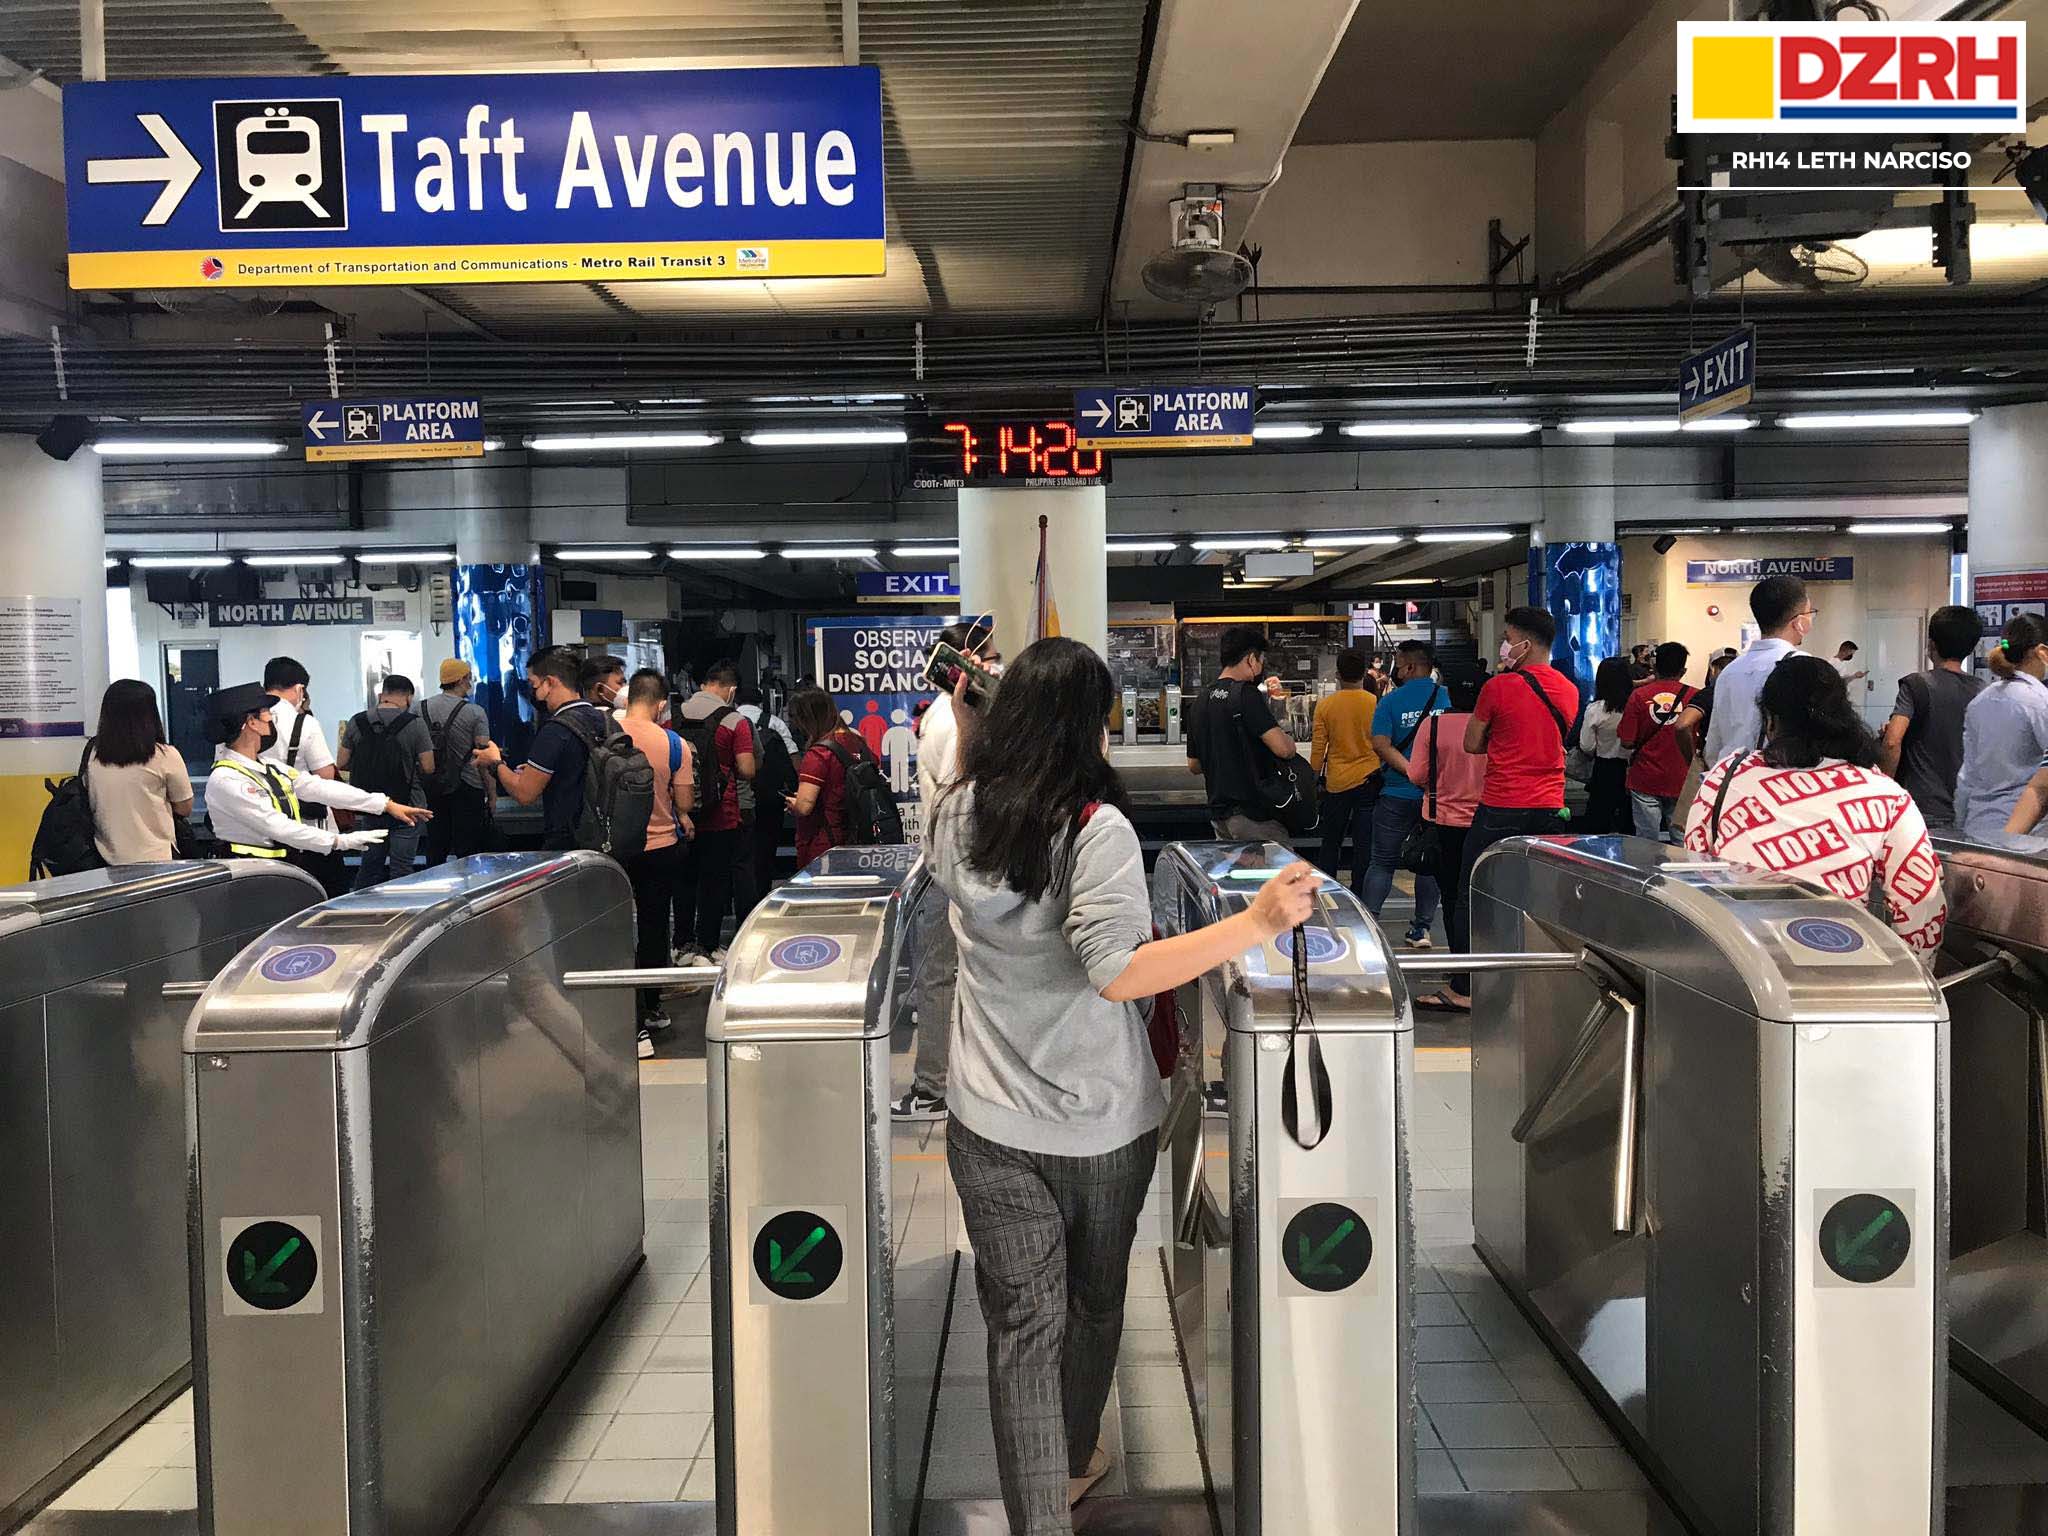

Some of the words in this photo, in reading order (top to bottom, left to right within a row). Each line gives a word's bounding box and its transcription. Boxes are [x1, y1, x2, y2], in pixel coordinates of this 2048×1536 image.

[361, 104, 528, 213] Taft
[555, 110, 857, 211] Avenue
[238, 263, 313, 276] Department
[317, 262, 331, 273] of
[335, 260, 429, 275] Transportation
[433, 260, 456, 271] and
[461, 258, 568, 271] Communications
[581, 257, 623, 268] Metro
[628, 256, 655, 267] Rail
[660, 255, 712, 267] Transit
[717, 255, 726, 266] 3
[1703, 340, 1749, 395] EXIT
[382, 400, 479, 421] PLATFORM
[1153, 391, 1248, 412] PLATFORM
[405, 422, 455, 440] AREA
[1174, 413, 1224, 431] AREA
[1704, 561, 1761, 575] NORTH
[1766, 560, 1835, 573] AVENUE
[886, 575, 949, 593] EXIT
[218, 604, 284, 622] NORTH
[292, 602, 364, 621] AVENUE
[854, 630, 942, 648] OBSERVE
[855, 649, 926, 669] SOCIA
[828, 673, 938, 693] DISTANC
[1767, 763, 1865, 802] NOPE
[904, 818, 920, 830] ith
[905, 832, 921, 844] he
[1895, 841, 1935, 900] NOP
